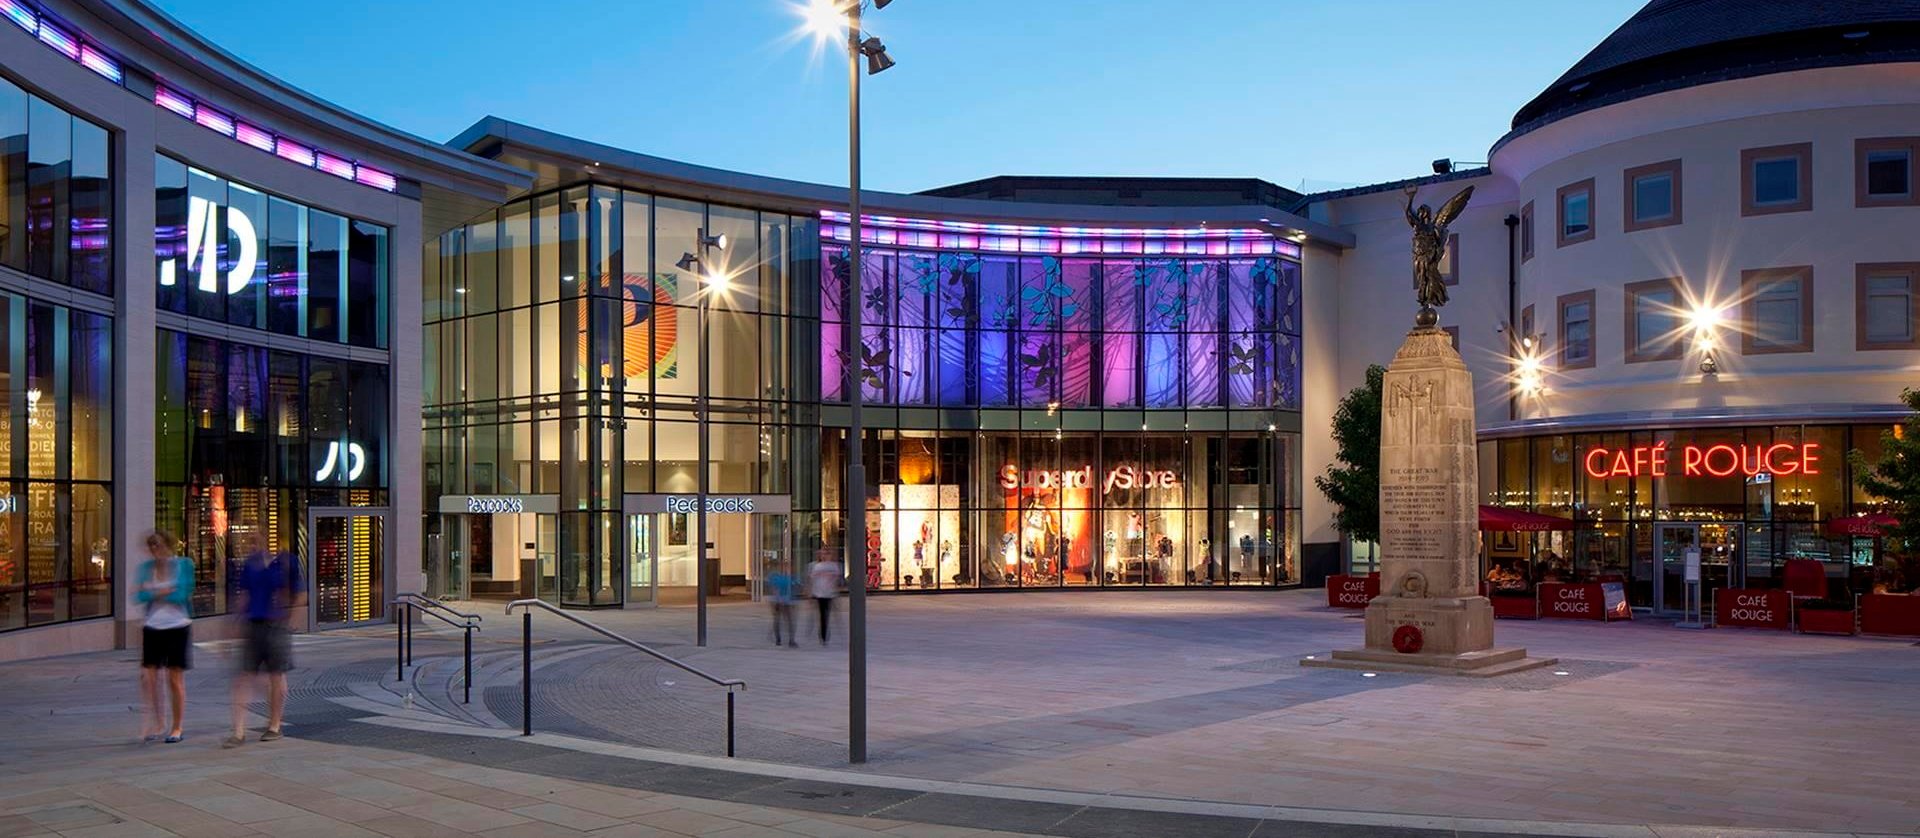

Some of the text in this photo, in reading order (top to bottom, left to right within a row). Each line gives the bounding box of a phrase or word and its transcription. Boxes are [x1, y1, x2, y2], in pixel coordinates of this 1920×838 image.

[1586, 440, 1819, 477] CAFÉ ROUGE
[467, 496, 523, 513] Peacocks
[1343, 581, 1365, 591] CAFÉ
[1559, 588, 1585, 599] CAFÉ
[1737, 594, 1767, 607] CAFÉ
[1554, 602, 1590, 613] ROUGE
[1731, 608, 1773, 621] ROUGE
